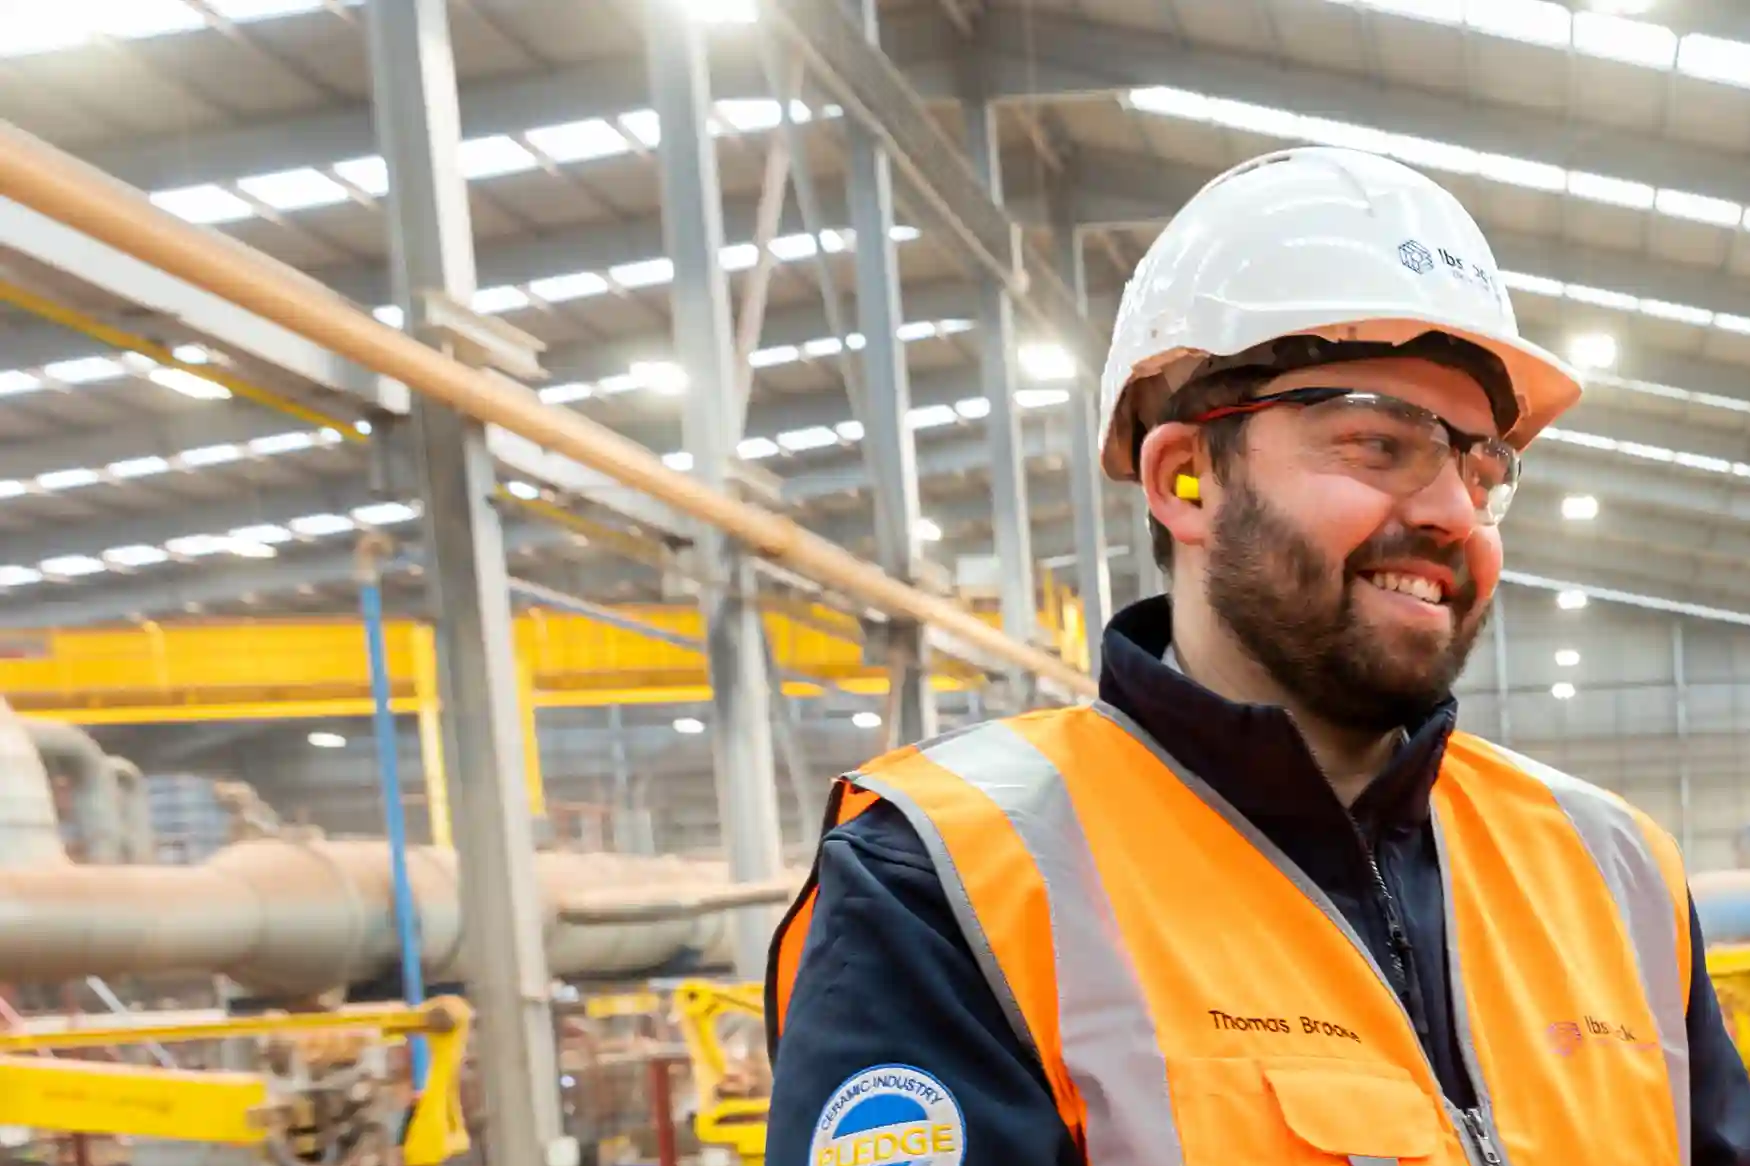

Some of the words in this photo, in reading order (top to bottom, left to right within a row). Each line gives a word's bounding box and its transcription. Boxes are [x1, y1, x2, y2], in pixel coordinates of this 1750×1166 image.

[1208, 1009, 1291, 1033] Thomas
[822, 1080, 869, 1130] CERAMIC
[873, 1075, 943, 1105] INDUSTRY
